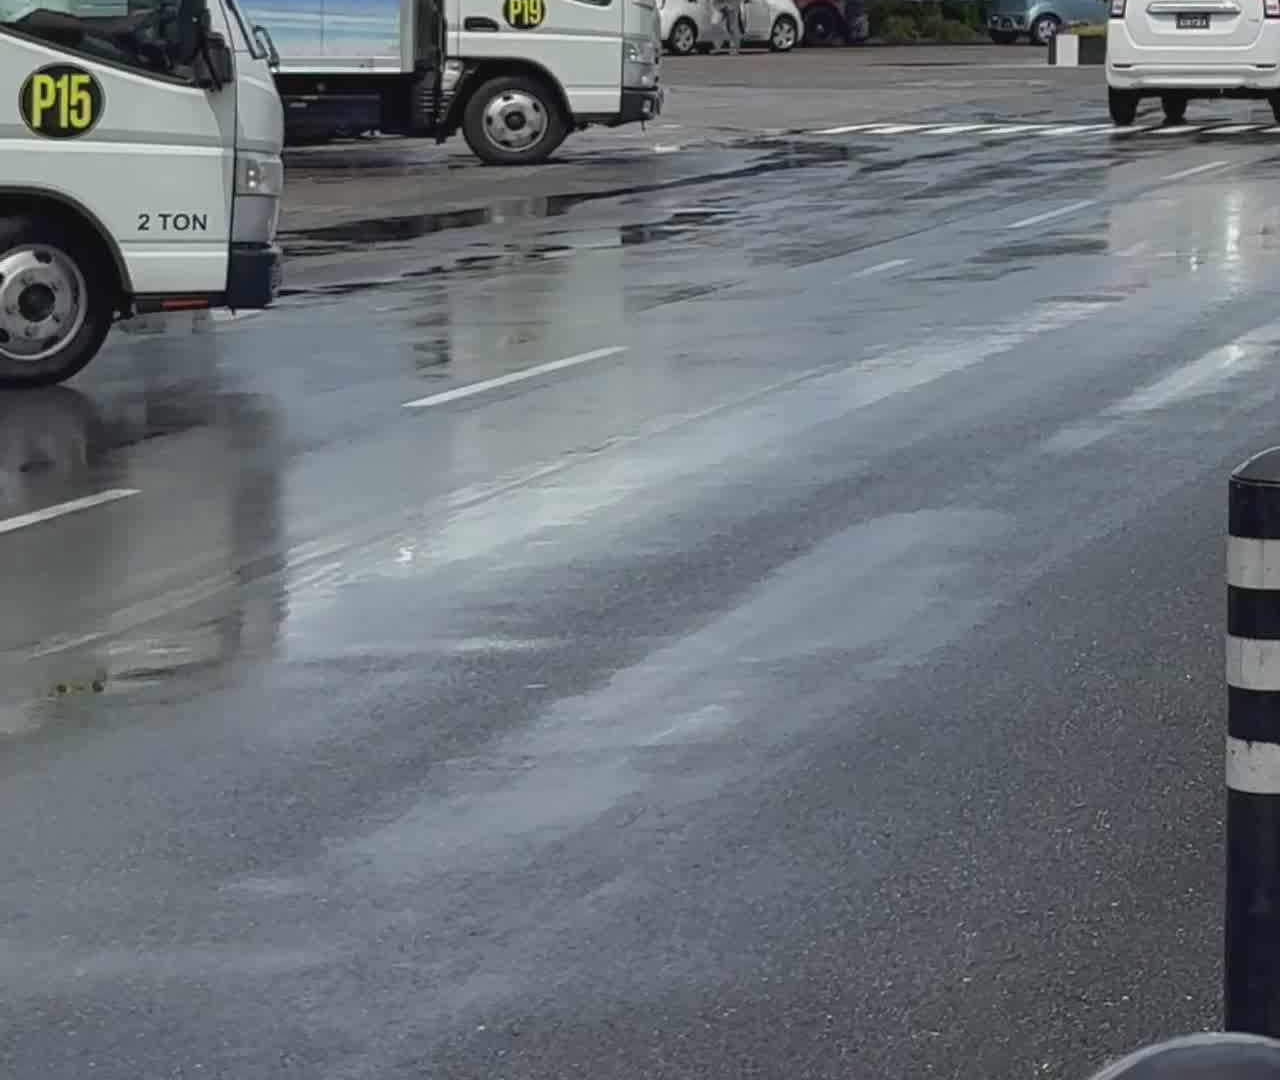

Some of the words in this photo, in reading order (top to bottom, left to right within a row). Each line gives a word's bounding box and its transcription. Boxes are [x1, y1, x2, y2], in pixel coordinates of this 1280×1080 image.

[31, 73, 92, 128] P15
[137, 214, 151, 232] 2
[158, 214, 208, 232] TON
